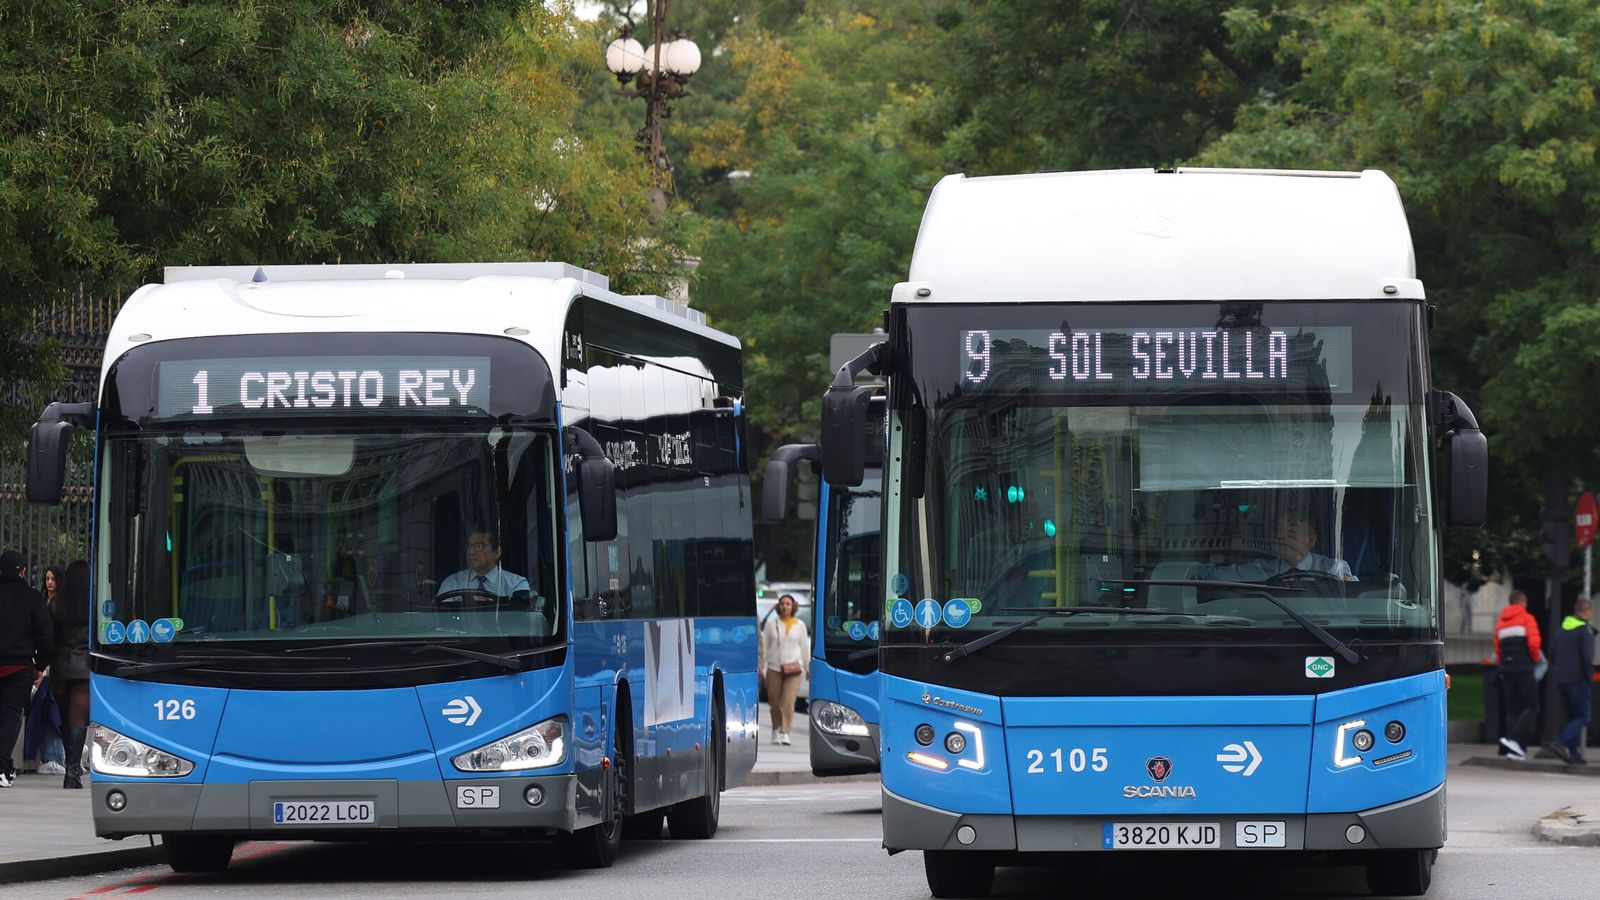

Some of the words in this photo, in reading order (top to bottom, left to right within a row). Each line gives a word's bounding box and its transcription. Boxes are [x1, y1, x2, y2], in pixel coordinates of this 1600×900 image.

[965, 329, 991, 383] 9
[1048, 331, 1113, 380] SOL
[1132, 331, 1288, 379] SEVILLA
[192, 370, 214, 414] 1
[239, 371, 384, 408] CRISTO
[398, 369, 476, 406] REY
[153, 700, 196, 720] 126
[1027, 747, 1109, 774] 2105
[462, 788, 494, 806] SP
[1123, 785, 1196, 798] SCANIA
[286, 805, 330, 821] 2022
[336, 805, 370, 821] LCD
[1118, 826, 1170, 845] 3820
[1177, 826, 1216, 845] KJD
[1243, 824, 1278, 844] SP
